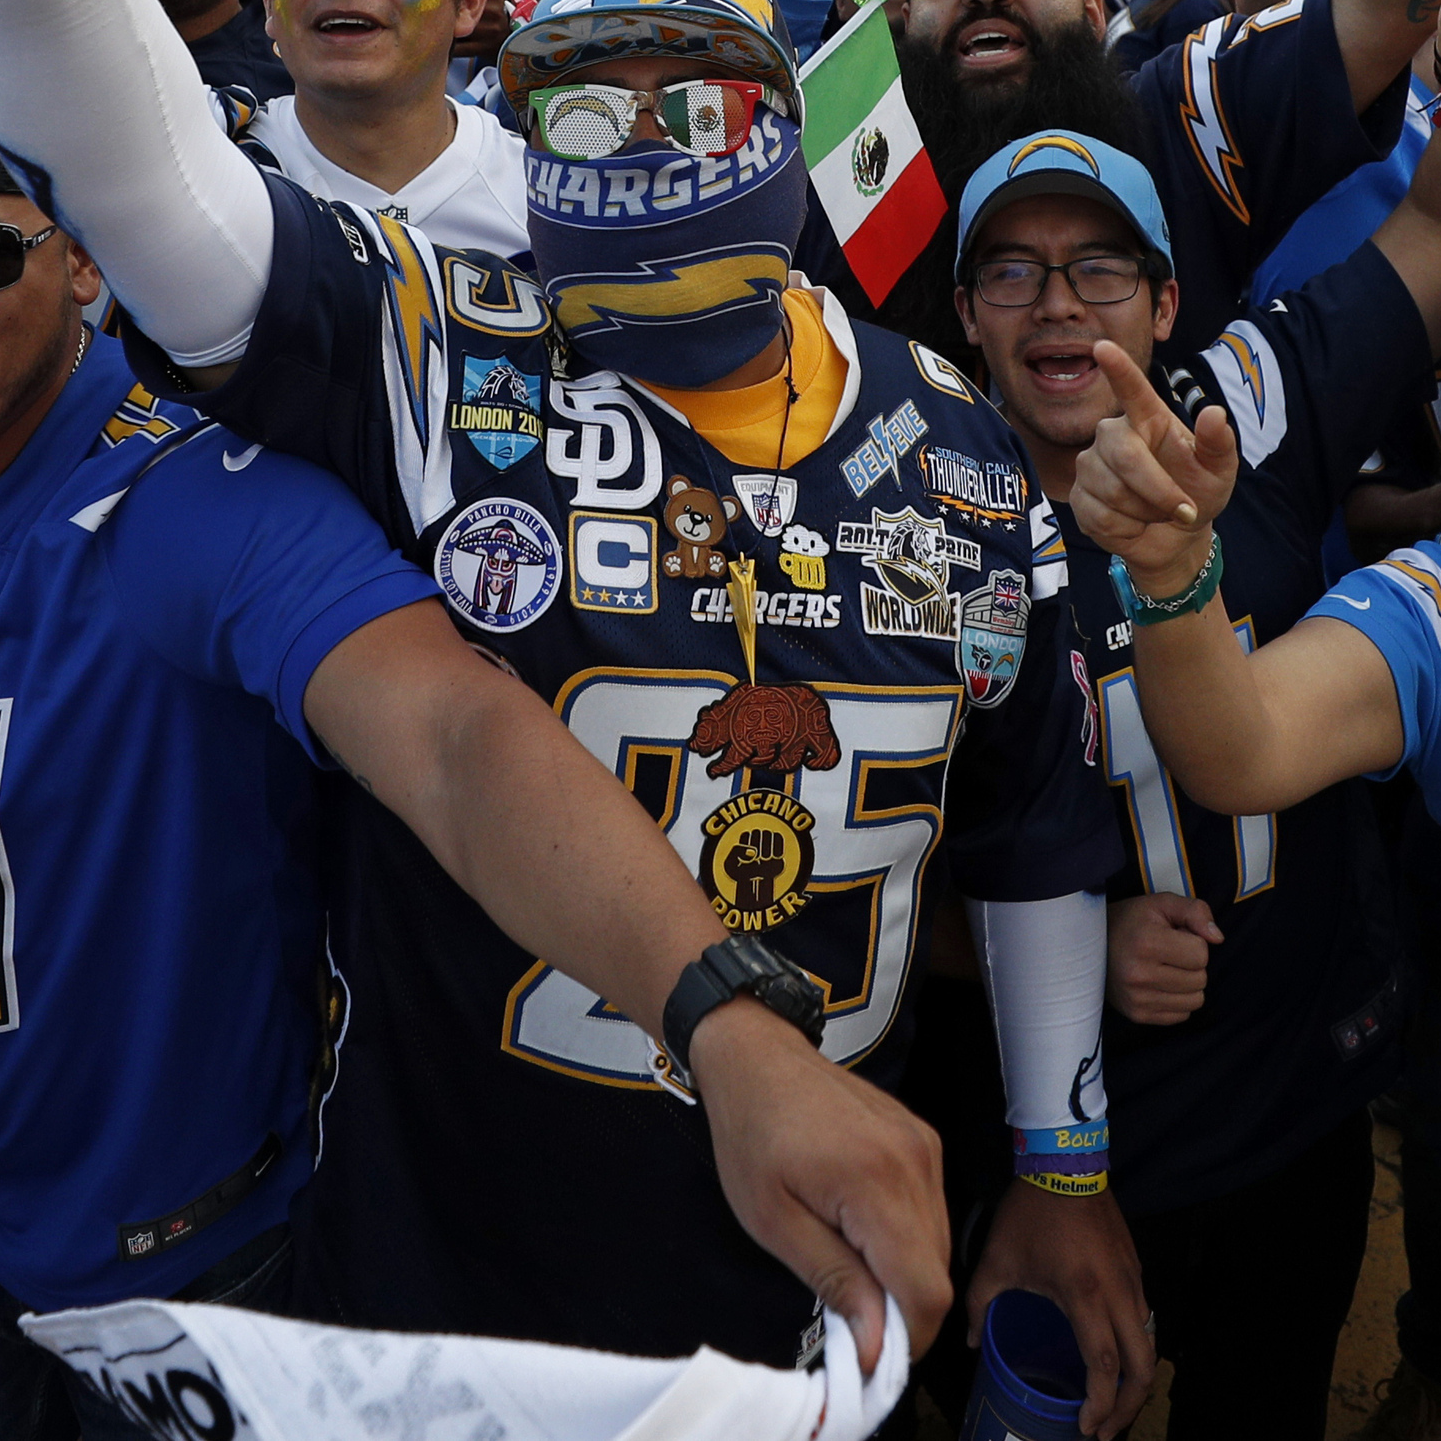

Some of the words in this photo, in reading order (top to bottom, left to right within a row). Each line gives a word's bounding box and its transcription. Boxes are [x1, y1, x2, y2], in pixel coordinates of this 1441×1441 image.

[527, 111, 784, 219] CHARGERS
[450, 403, 514, 431] LONDON
[466, 504, 510, 524] PANCHO
[514, 508, 543, 534] BILLA
[756, 508, 781, 526] NFL
[839, 525, 890, 548] BOLT
[934, 535, 981, 563] PRIDE
[576, 520, 650, 589] C
[509, 603, 536, 626] 2019
[690, 587, 843, 629] CHRGERS
[864, 586, 959, 640] WORLDWIDE
[965, 629, 1024, 655] LONDON
[705, 792, 813, 836] CHICANO
[710, 891, 807, 932] POWER
[1055, 1129, 1101, 1149] BOLT
[1050, 1177, 1099, 1194] Helmet
